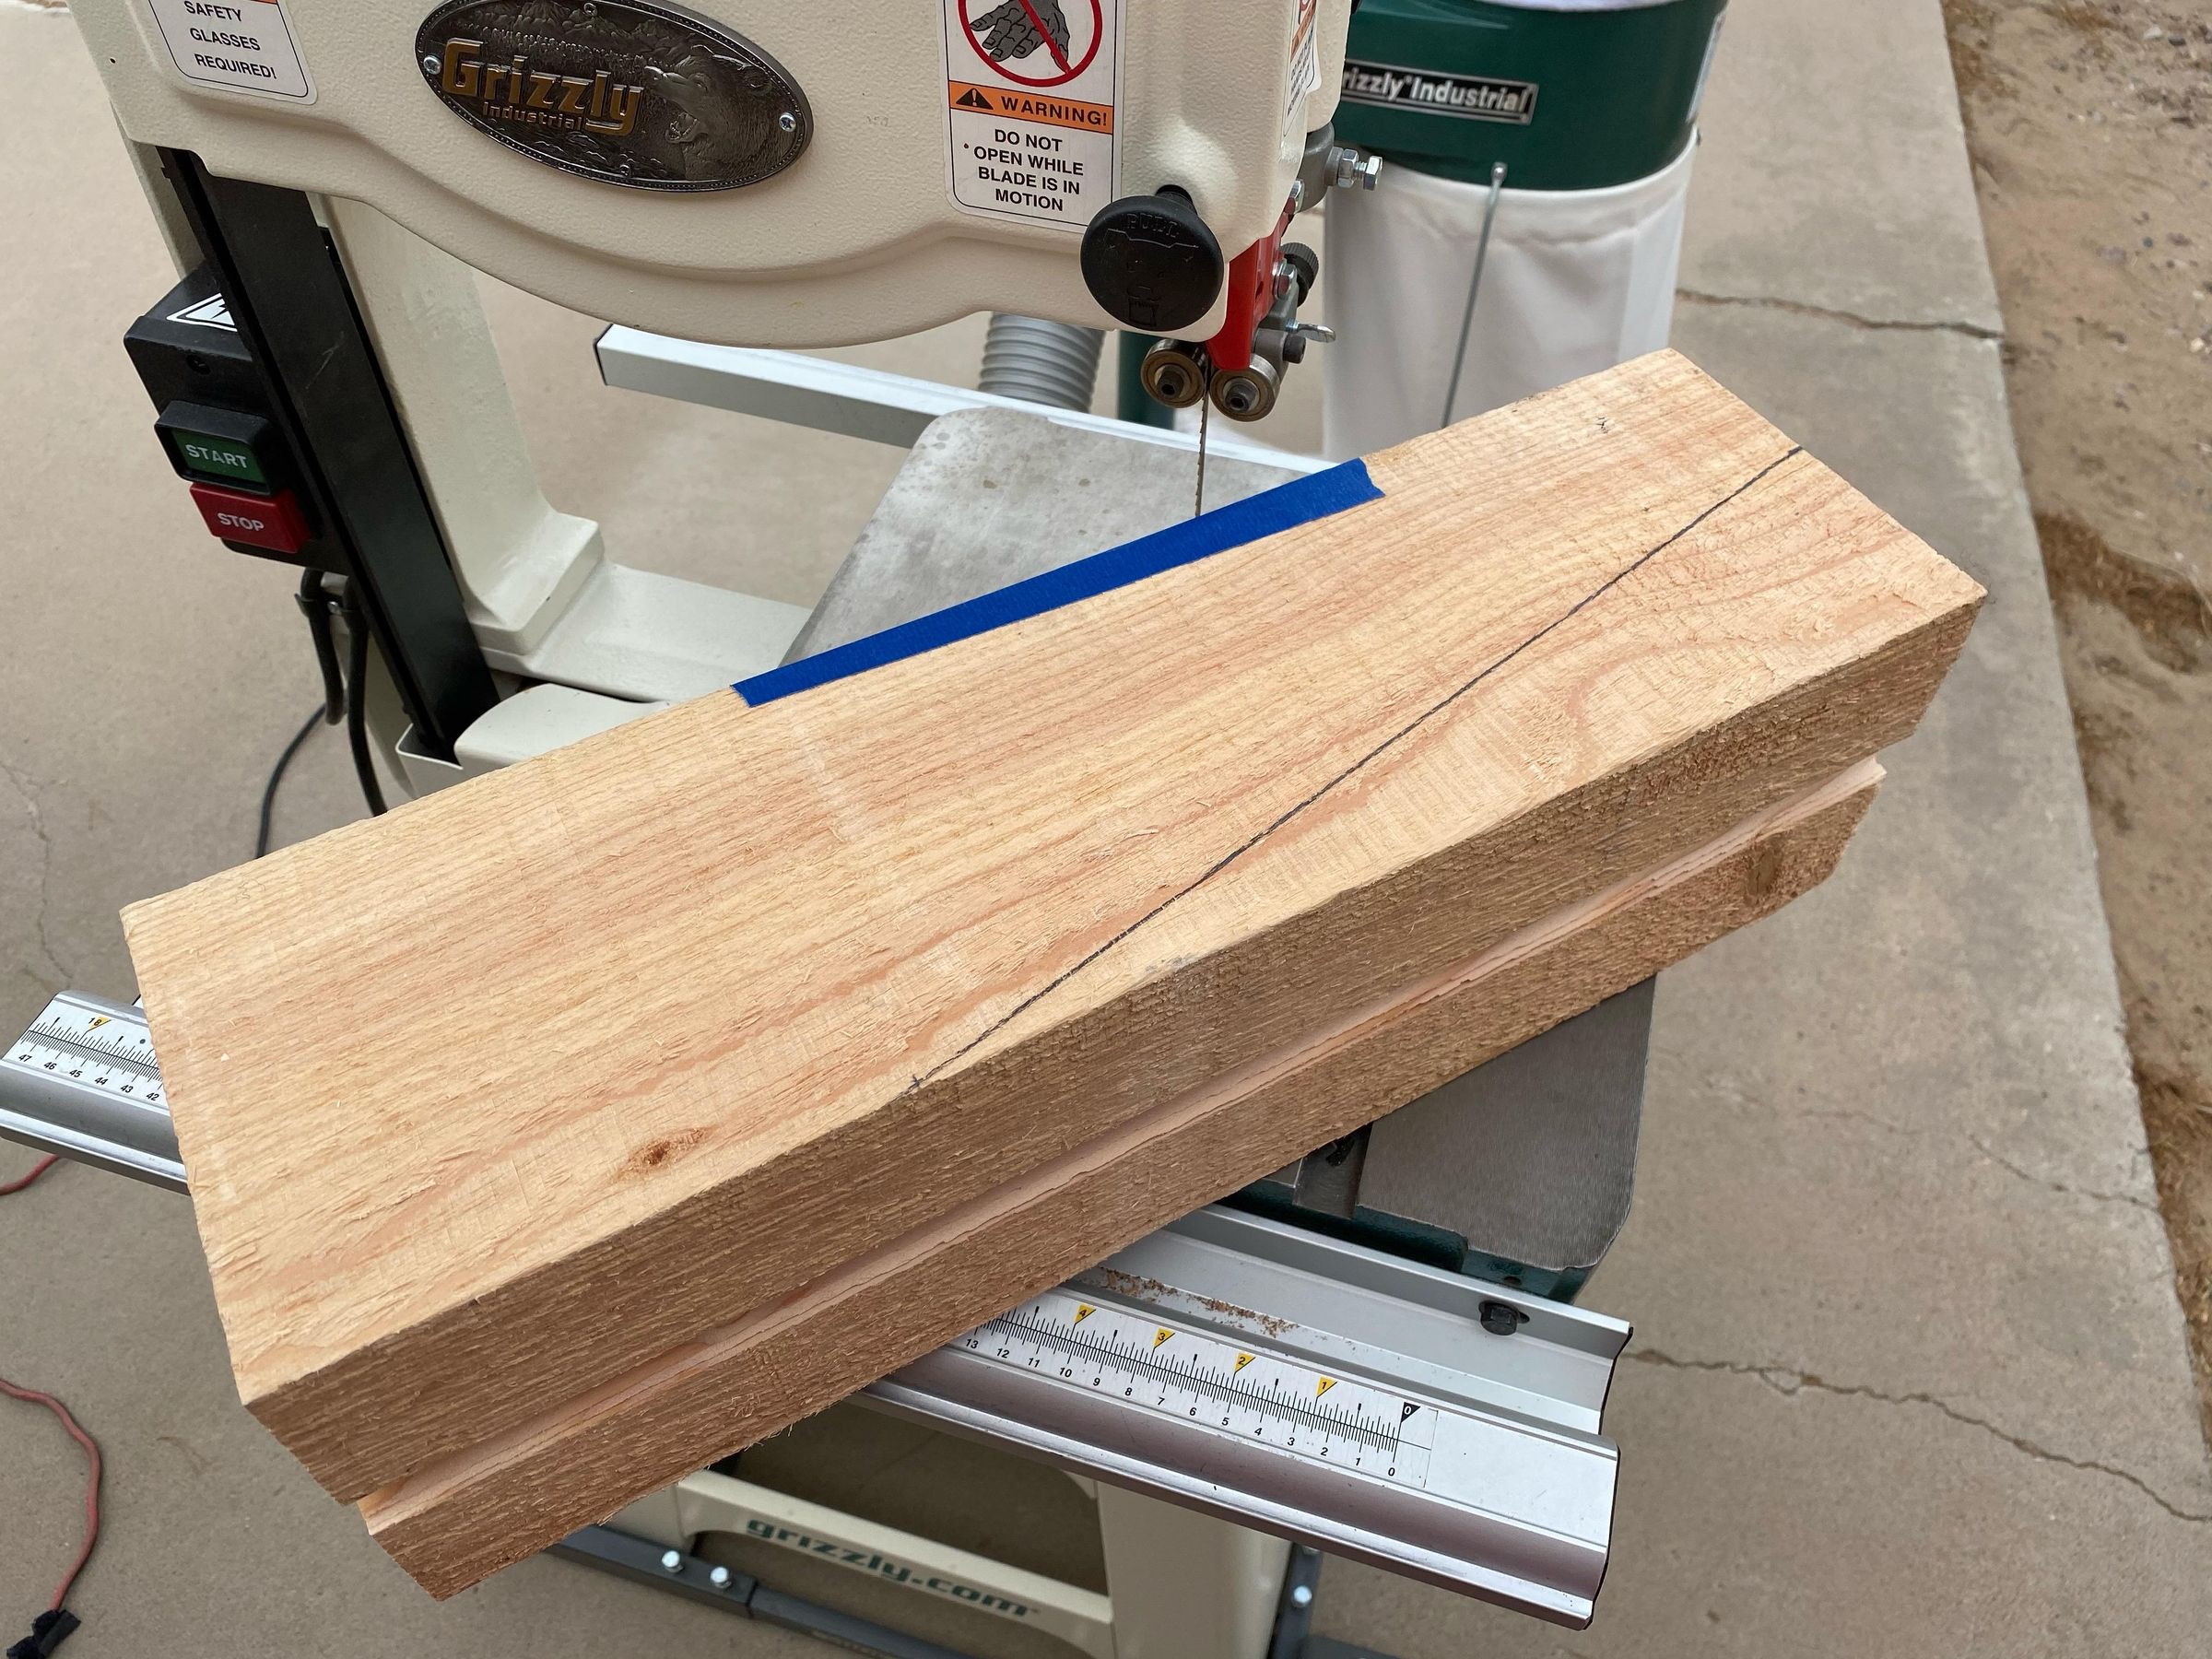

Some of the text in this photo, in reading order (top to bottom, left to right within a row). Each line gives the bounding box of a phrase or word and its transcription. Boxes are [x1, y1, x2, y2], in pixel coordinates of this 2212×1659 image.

[184, 1, 241, 21] SAFETY
[190, 28, 261, 51] GLASSES
[194, 53, 276, 79] REQUIRED!
[441, 37, 644, 136] Grizzly
[1342, 67, 1533, 112] rizzly Industrial
[482, 101, 583, 131] Industrial
[1001, 95, 1107, 126] WARNING!
[994, 129, 1062, 151] DO NOT
[973, 146, 1084, 175] OPEN WHILE
[978, 166, 1080, 194] BLADE IS IN
[995, 188, 1063, 211] MOTION
[185, 444, 247, 468] START
[218, 512, 264, 531] STOP
[18, 1053, 159, 1101] 47 46 45 44 43 42
[1078, 1309, 1087, 1317] 4
[1158, 1332, 1166, 1341] 3
[1238, 1357, 1245, 1365] 2
[1404, 1406, 1411, 1415] 0
[966, 1338, 1395, 1477] 13 12 11 10 9 8 7 6 5 4 3 2 1 0
[747, 1520, 1028, 1616] grizzly.com
